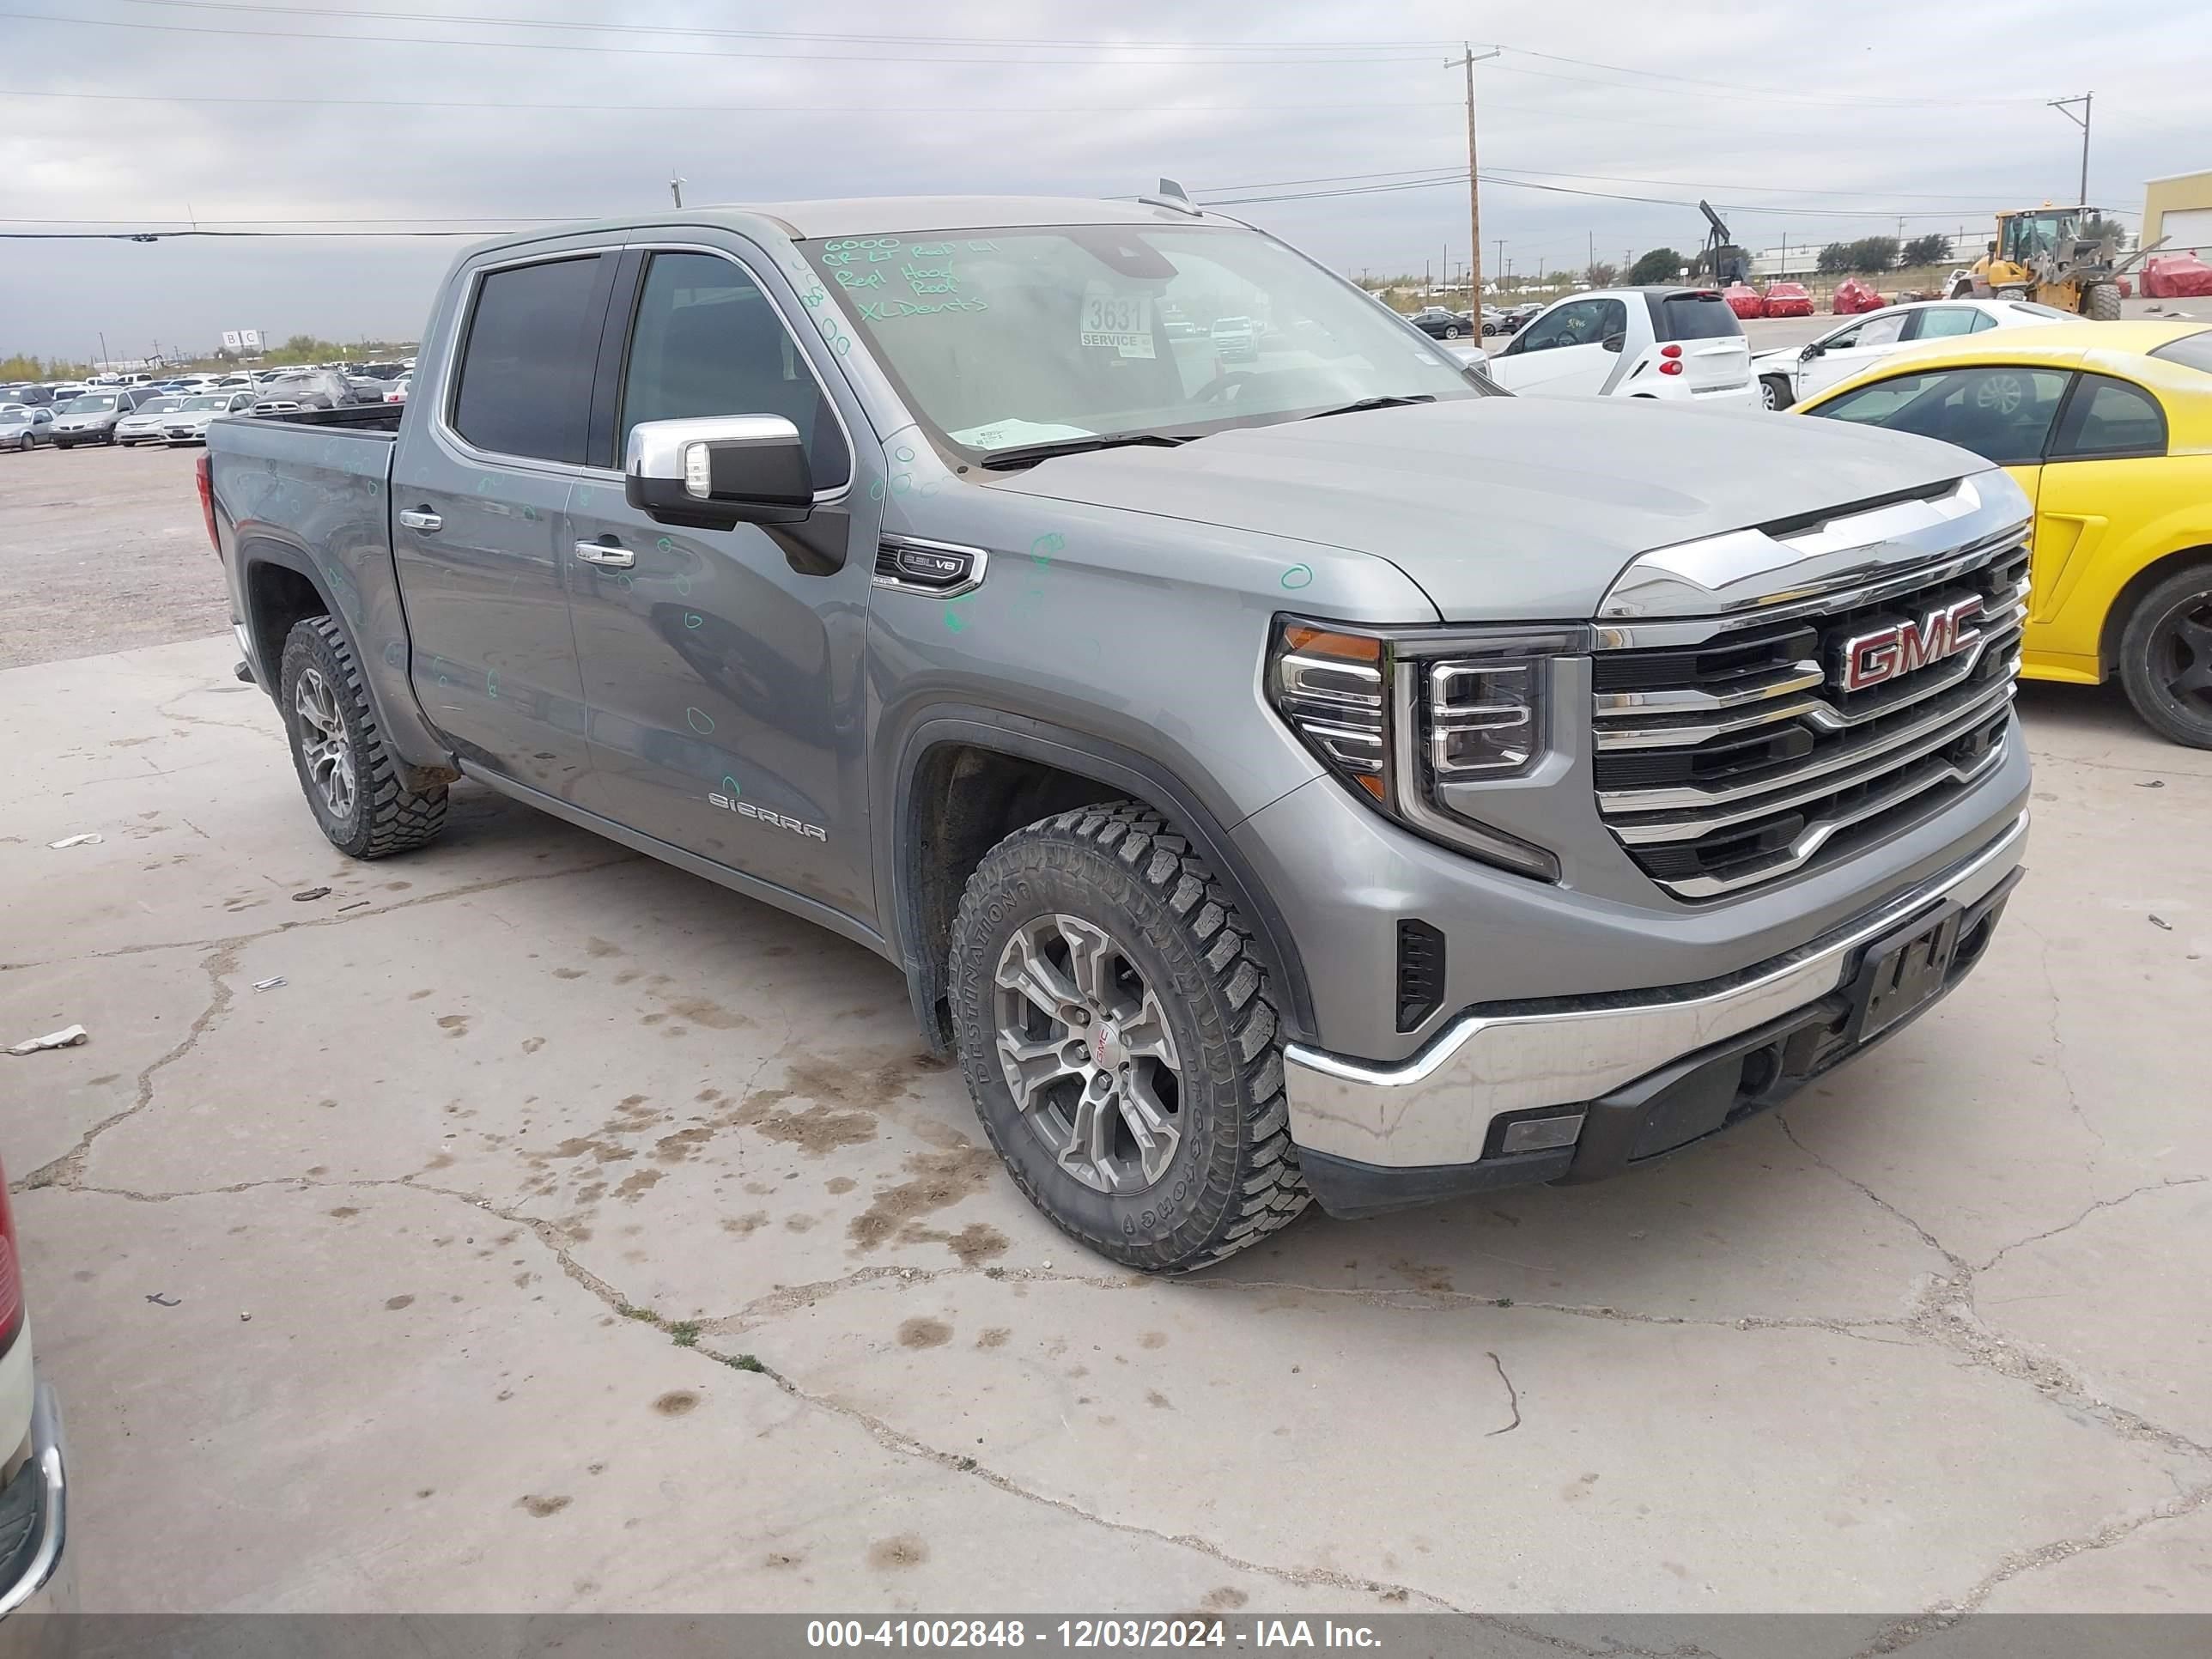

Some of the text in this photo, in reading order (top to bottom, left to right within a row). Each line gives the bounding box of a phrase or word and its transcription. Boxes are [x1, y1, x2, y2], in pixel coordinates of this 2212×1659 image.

[824, 238, 901, 252] 6000
[835, 260, 954, 290] Repl Hood
[1091, 298, 1141, 331] 3631
[227, 334, 235, 344] B
[246, 332, 255, 343] C
[1083, 334, 1138, 347] SERVICE
[1844, 593, 1984, 693] GMC
[708, 793, 828, 842] SIERRA
[963, 890, 1018, 1084] DESTINATION
[1096, 1028, 1109, 1065] GMC
